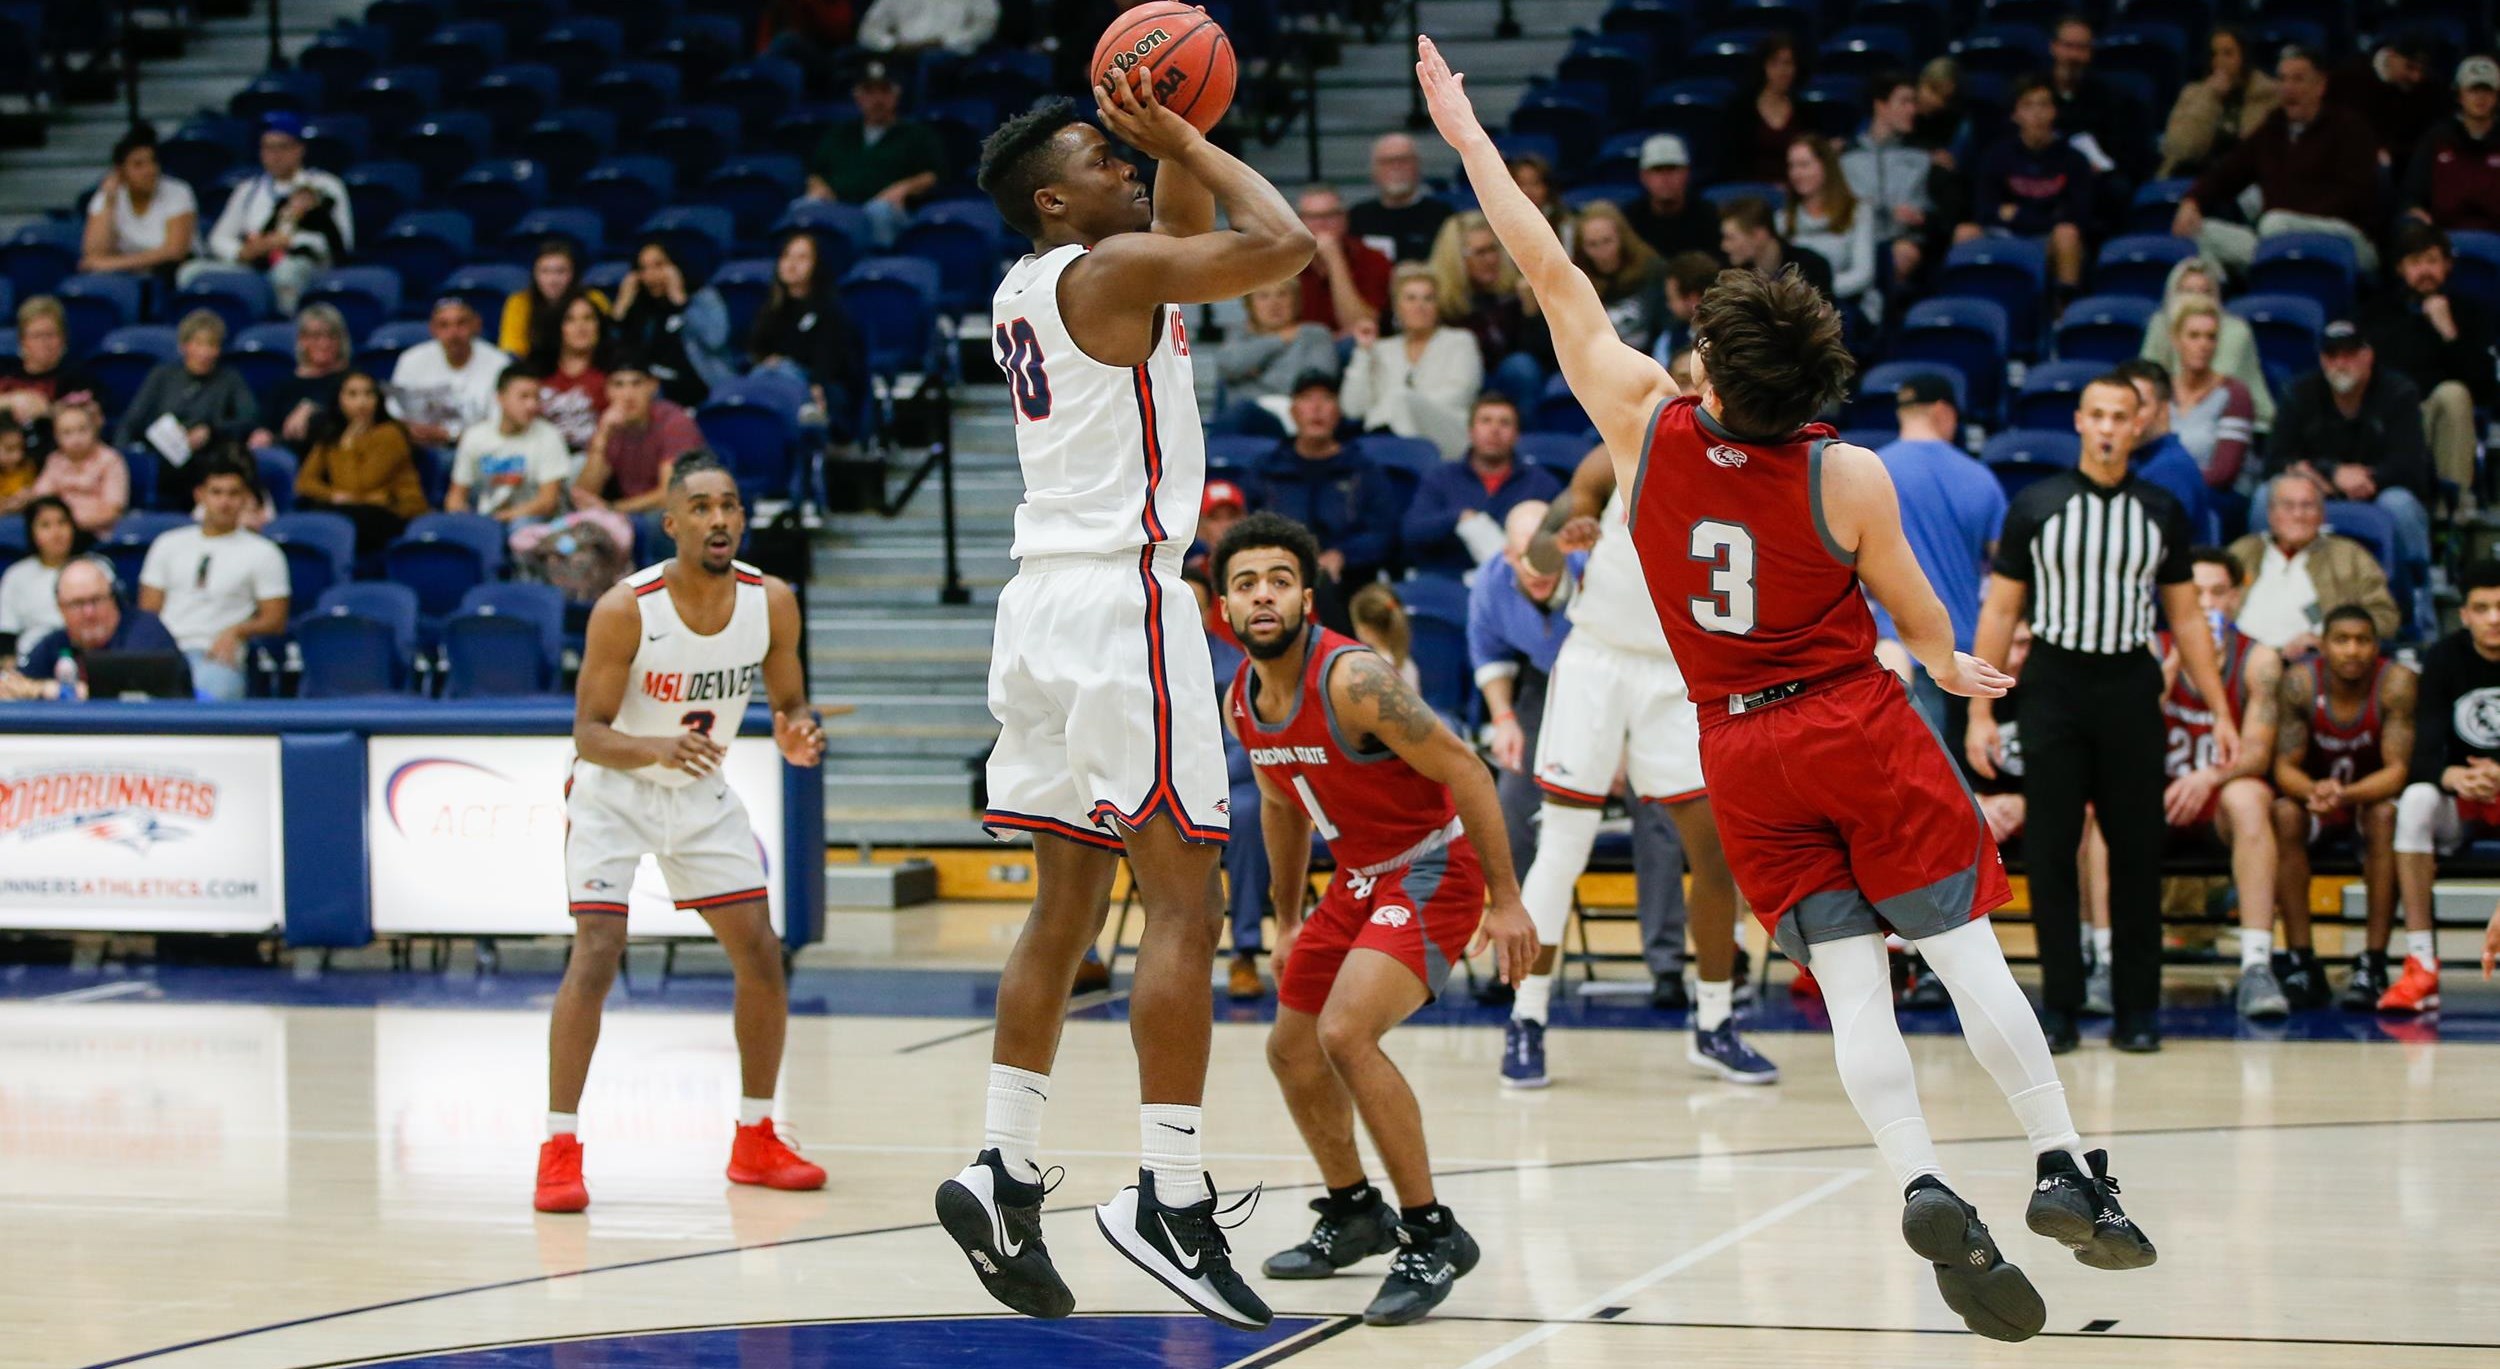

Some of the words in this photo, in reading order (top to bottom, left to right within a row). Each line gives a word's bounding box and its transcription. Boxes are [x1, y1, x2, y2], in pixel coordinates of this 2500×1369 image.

[1101, 28, 1171, 95] Wlson
[996, 316, 1053, 425] 10
[1689, 518, 1757, 636] 3
[1294, 747, 1328, 764] STATE
[2165, 726, 2219, 777] 20
[1291, 773, 1340, 841] 1
[0, 877, 258, 897] NNERSATHLETICS.COM
